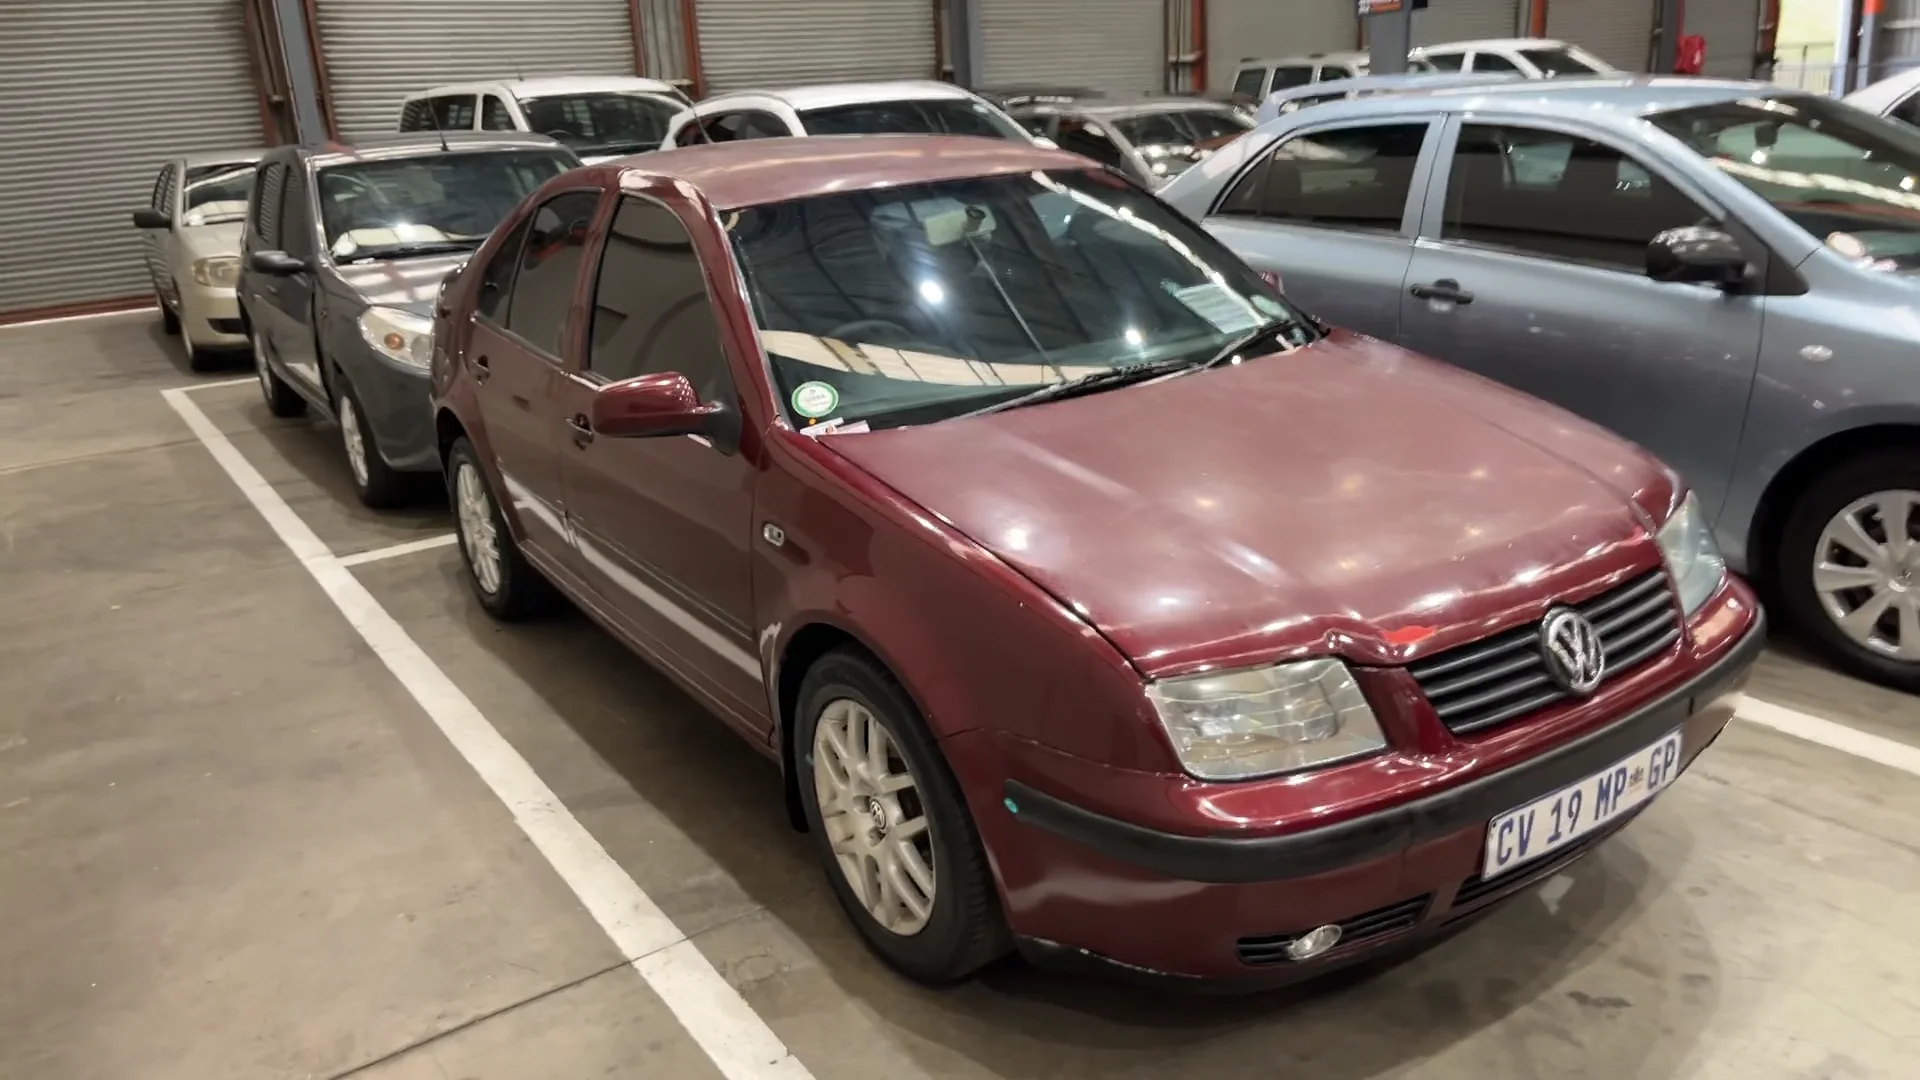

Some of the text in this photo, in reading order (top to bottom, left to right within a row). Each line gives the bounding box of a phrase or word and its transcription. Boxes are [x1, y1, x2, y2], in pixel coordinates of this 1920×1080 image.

[1496, 738, 1676, 866] CV 19 MP GP
